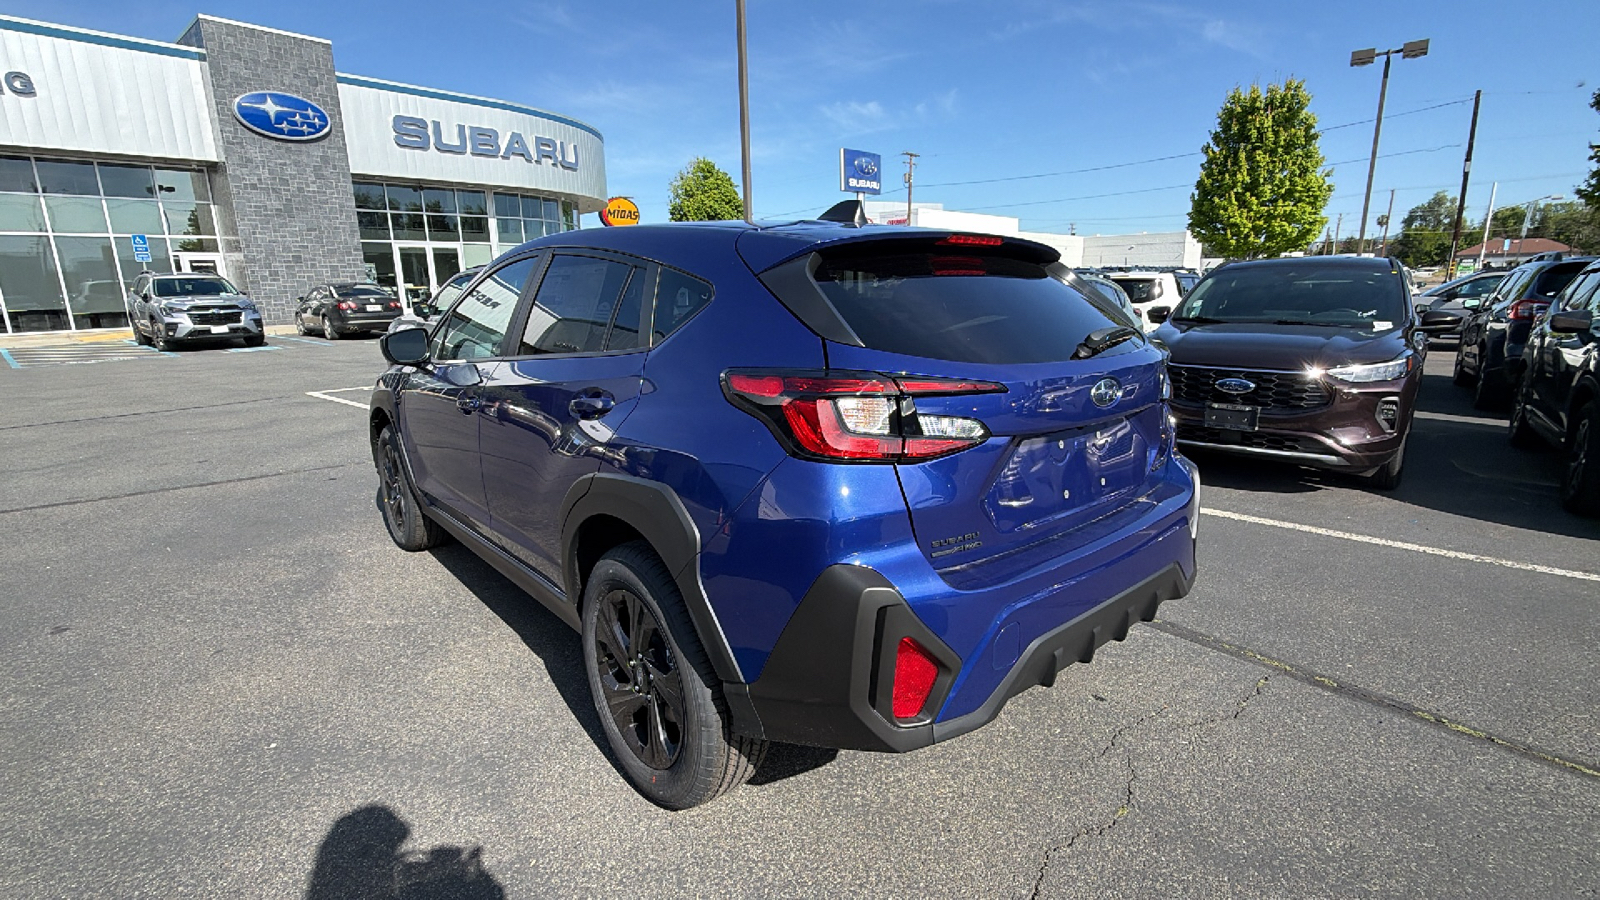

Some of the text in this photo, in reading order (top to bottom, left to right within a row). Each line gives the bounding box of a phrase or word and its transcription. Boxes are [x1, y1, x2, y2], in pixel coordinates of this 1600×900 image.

[392, 114, 579, 171] SUBARU
[849, 178, 880, 190] SUBARU
[607, 205, 639, 220] MIDAS
[932, 531, 980, 548] SUBARU
